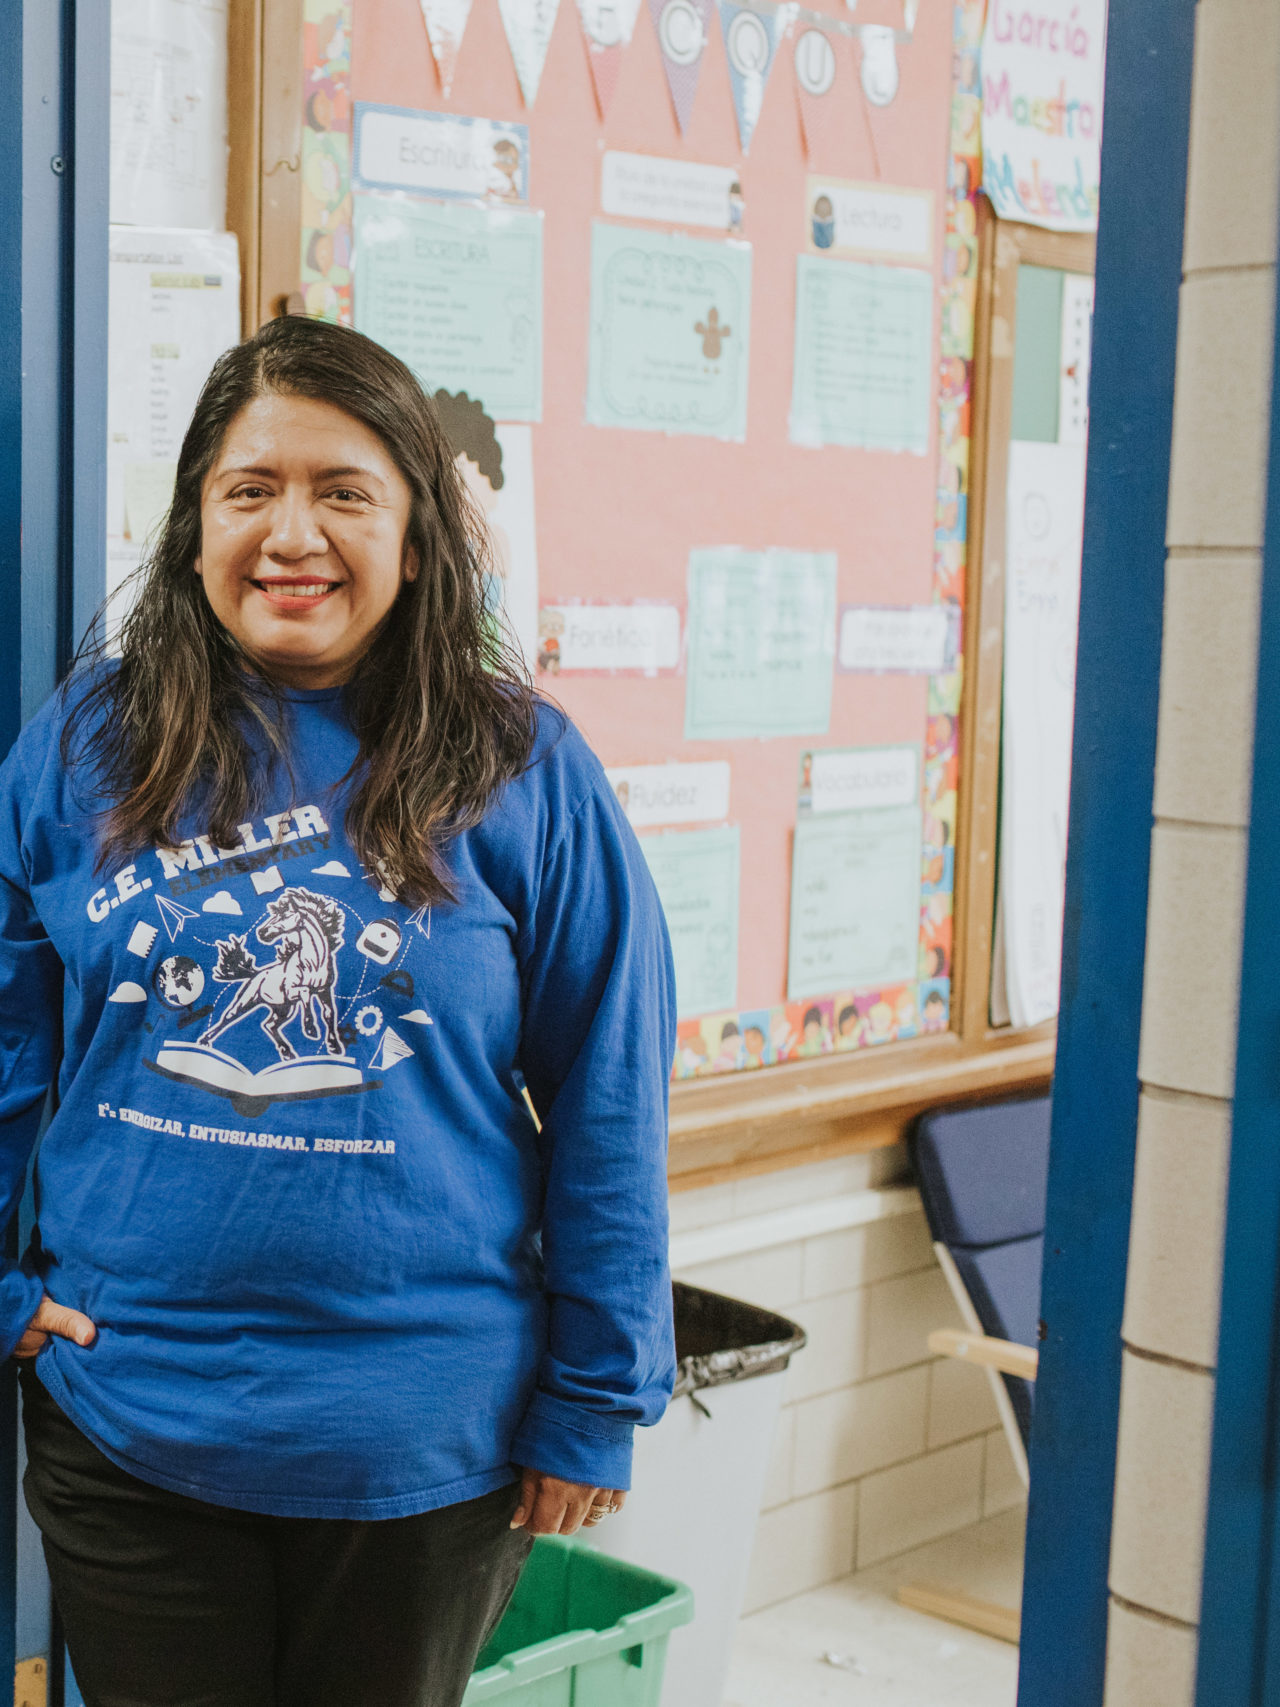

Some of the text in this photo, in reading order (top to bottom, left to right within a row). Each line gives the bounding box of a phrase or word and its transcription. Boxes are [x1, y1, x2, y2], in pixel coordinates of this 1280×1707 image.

[841, 205, 903, 232] Lectura
[631, 782, 698, 809] Fluidez
[86, 804, 330, 923] C.E. MILLER
[168, 833, 331, 897] ELEMENTARY
[188, 1124, 310, 1152] ENTUSIASMAR,
[313, 1138, 396, 1154] ESFORZAR
